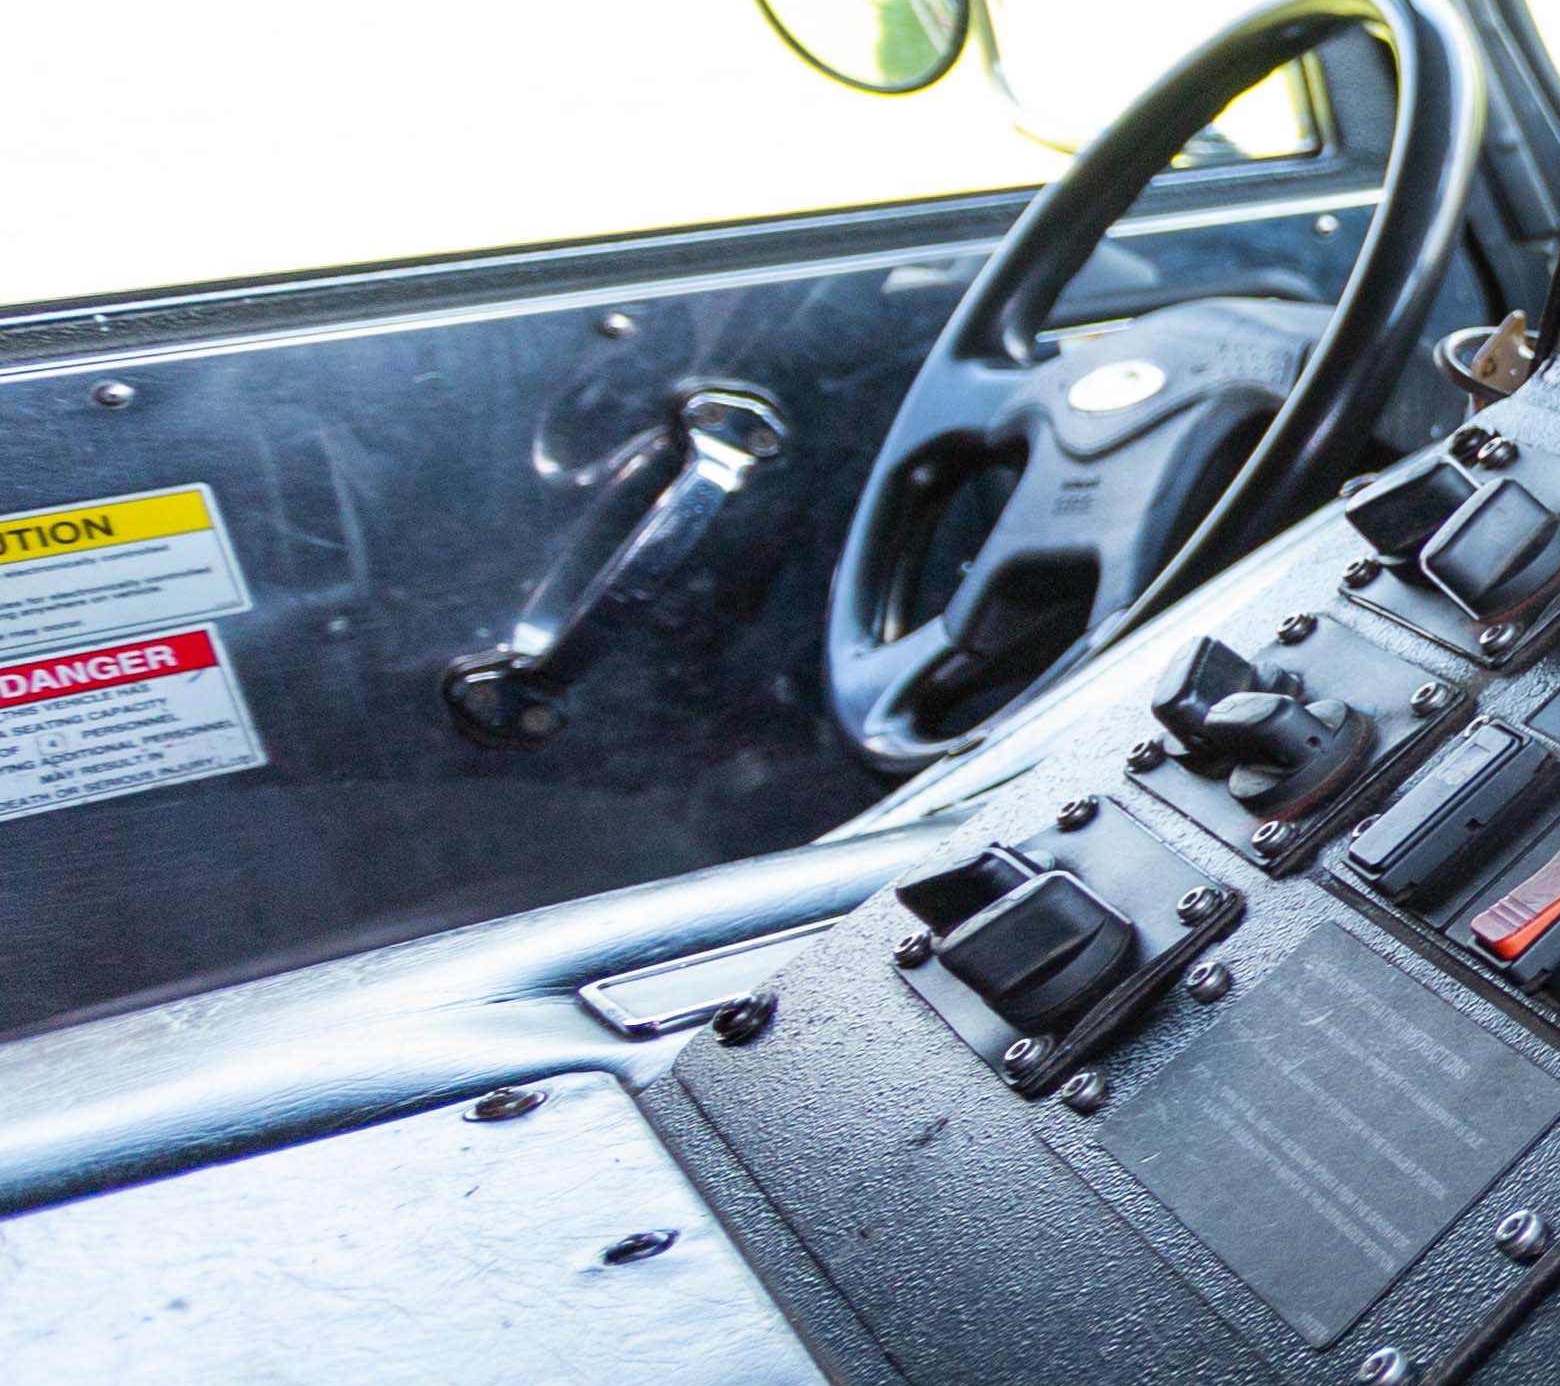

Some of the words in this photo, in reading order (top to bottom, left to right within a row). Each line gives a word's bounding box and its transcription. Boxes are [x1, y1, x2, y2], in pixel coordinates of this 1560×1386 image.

[0, 642, 178, 700] DANGER
[40, 690, 111, 713] VEHICLE
[115, 683, 150, 698] HAS
[12, 714, 83, 737] SEATING
[87, 697, 167, 721] CAPACITY
[80, 711, 180, 740] PERSONNEL
[41, 738, 138, 767] ADDITIONAL
[141, 718, 235, 745] PERSONNEL
[40, 769, 74, 784] MAY
[80, 754, 146, 776] RESULT
[149, 751, 164, 761] IN
[55, 785, 79, 799] OR
[83, 769, 155, 793] SERIOUS
